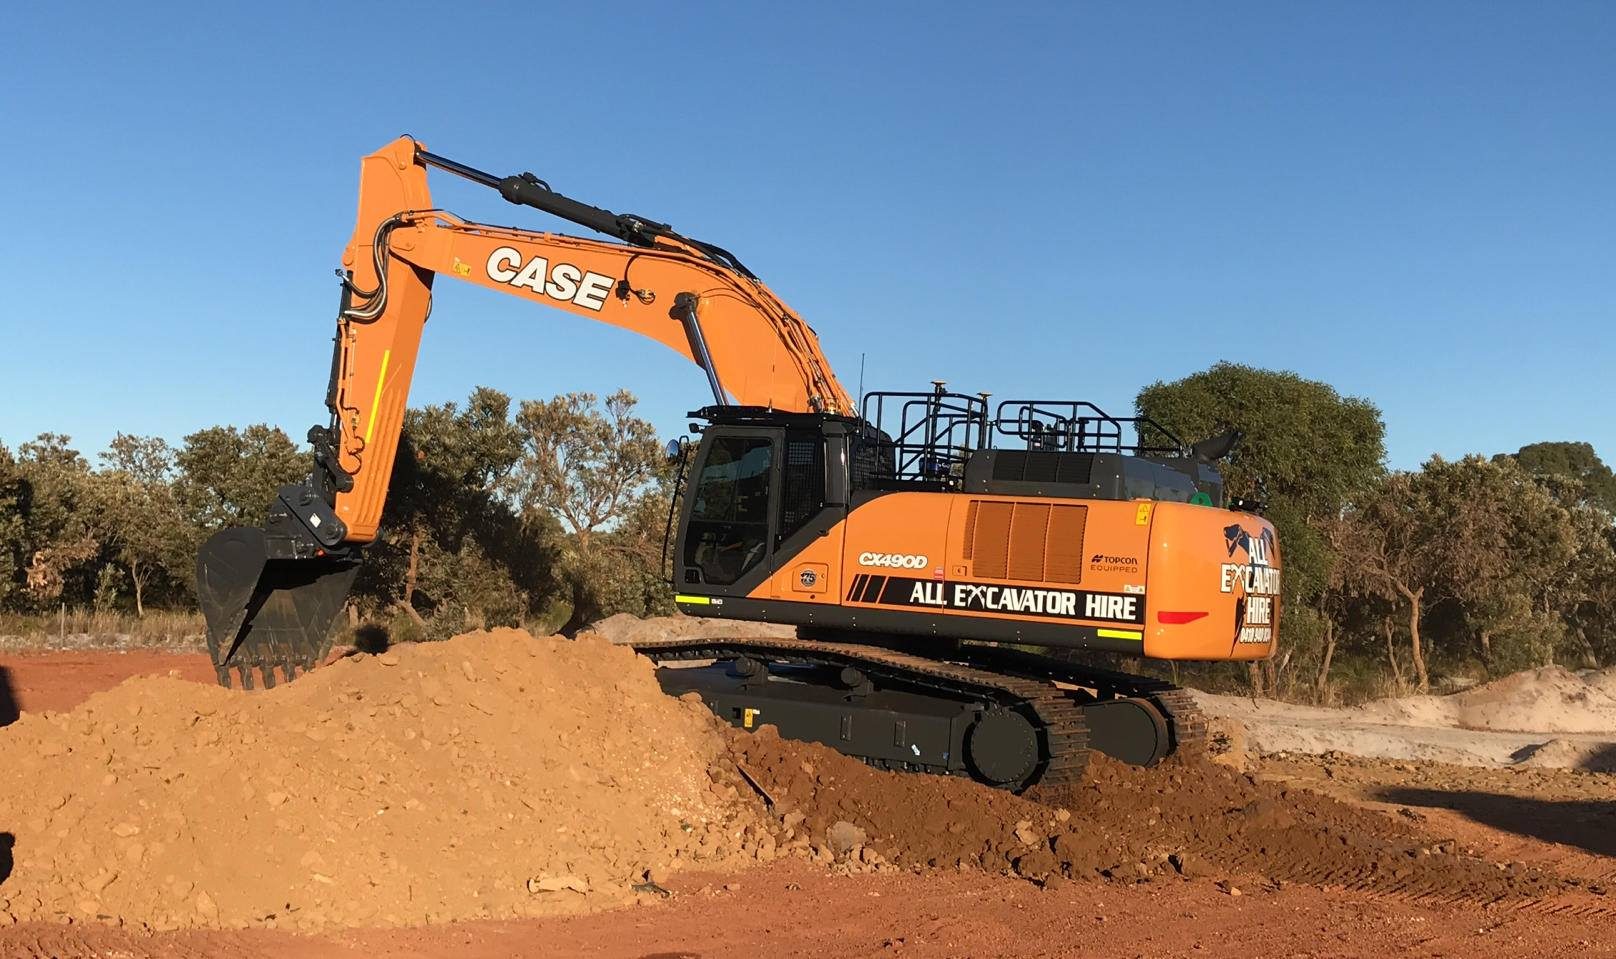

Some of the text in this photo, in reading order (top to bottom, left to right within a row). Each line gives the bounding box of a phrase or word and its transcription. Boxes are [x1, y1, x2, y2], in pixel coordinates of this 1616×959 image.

[486, 246, 616, 311] CASE
[858, 552, 928, 569] CX490D
[1248, 537, 1268, 565] ALL
[1090, 564, 1138, 574] EQUIPPED
[1220, 563, 1280, 595] EXCAVATO
[909, 581, 1137, 620] ALL EXCAVATOR HIRE
[1246, 596, 1271, 624] HIRE
